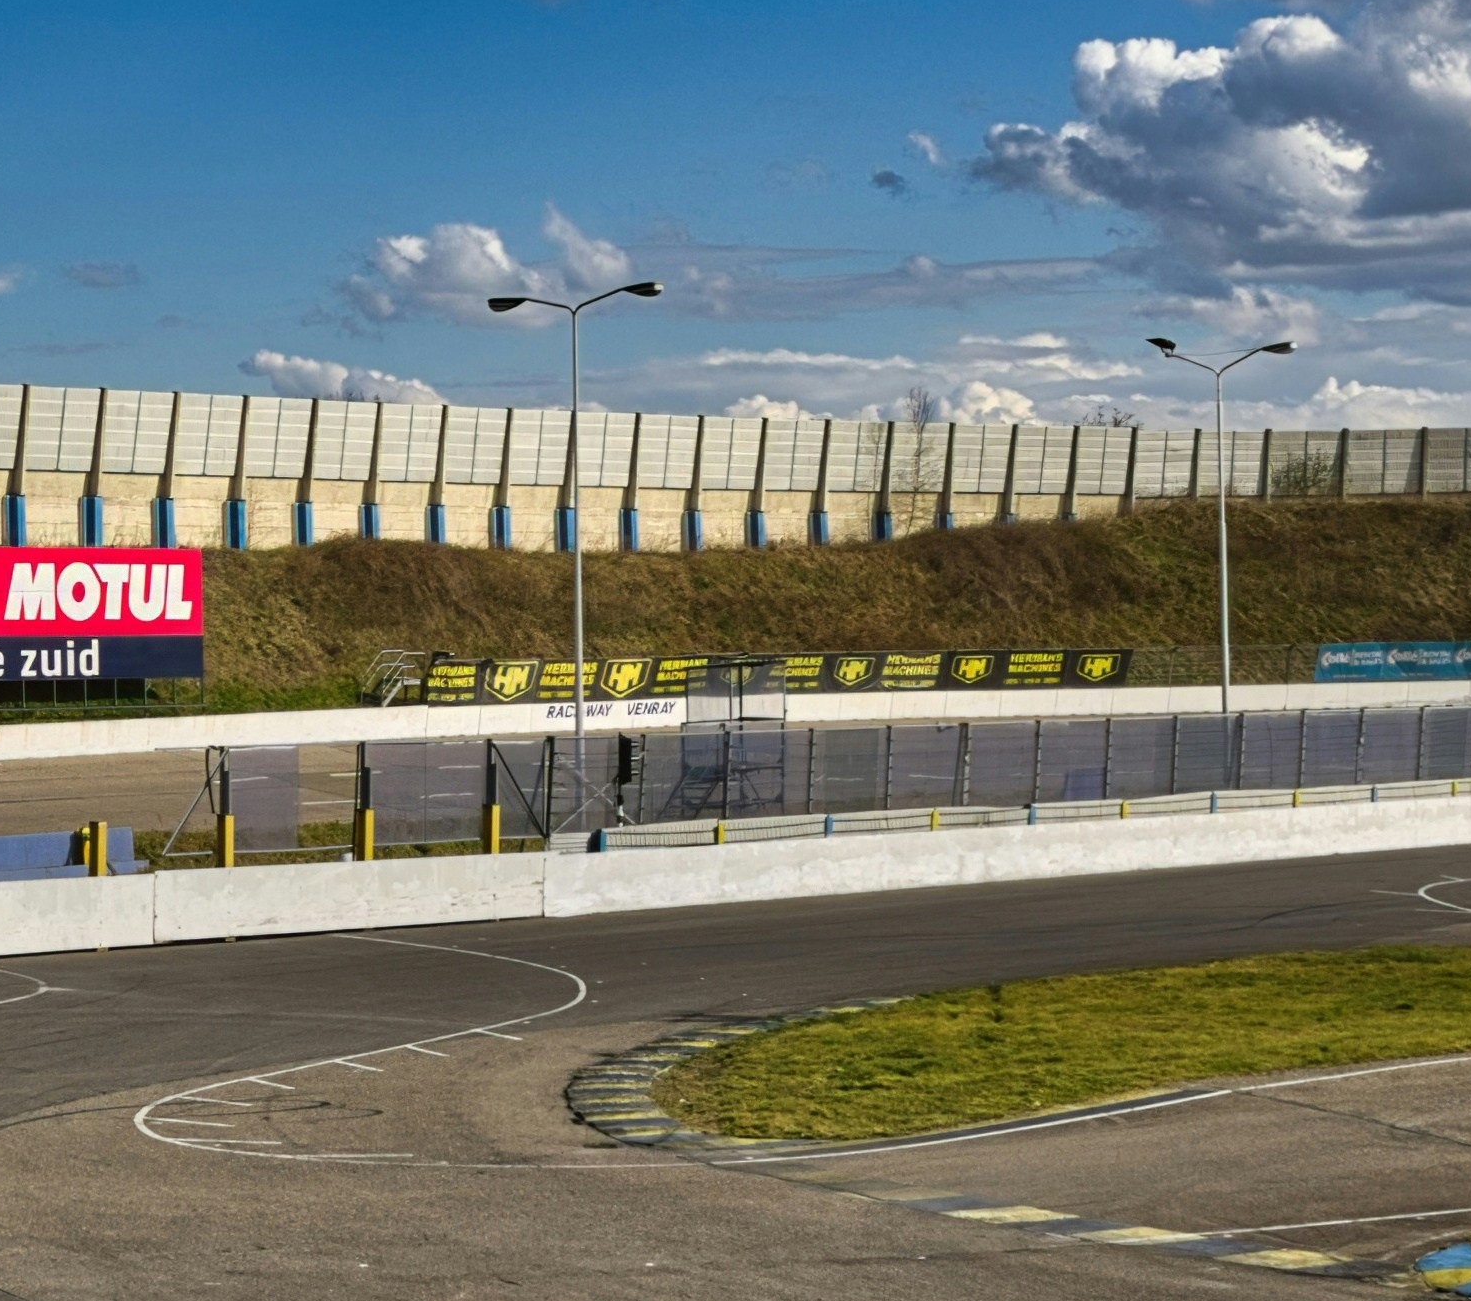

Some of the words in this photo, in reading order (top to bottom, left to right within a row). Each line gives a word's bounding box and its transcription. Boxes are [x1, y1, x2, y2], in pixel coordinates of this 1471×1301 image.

[3, 561, 192, 621] MOTUL
[21, 639, 100, 678] zuid
[546, 704, 613, 719] RACWAY
